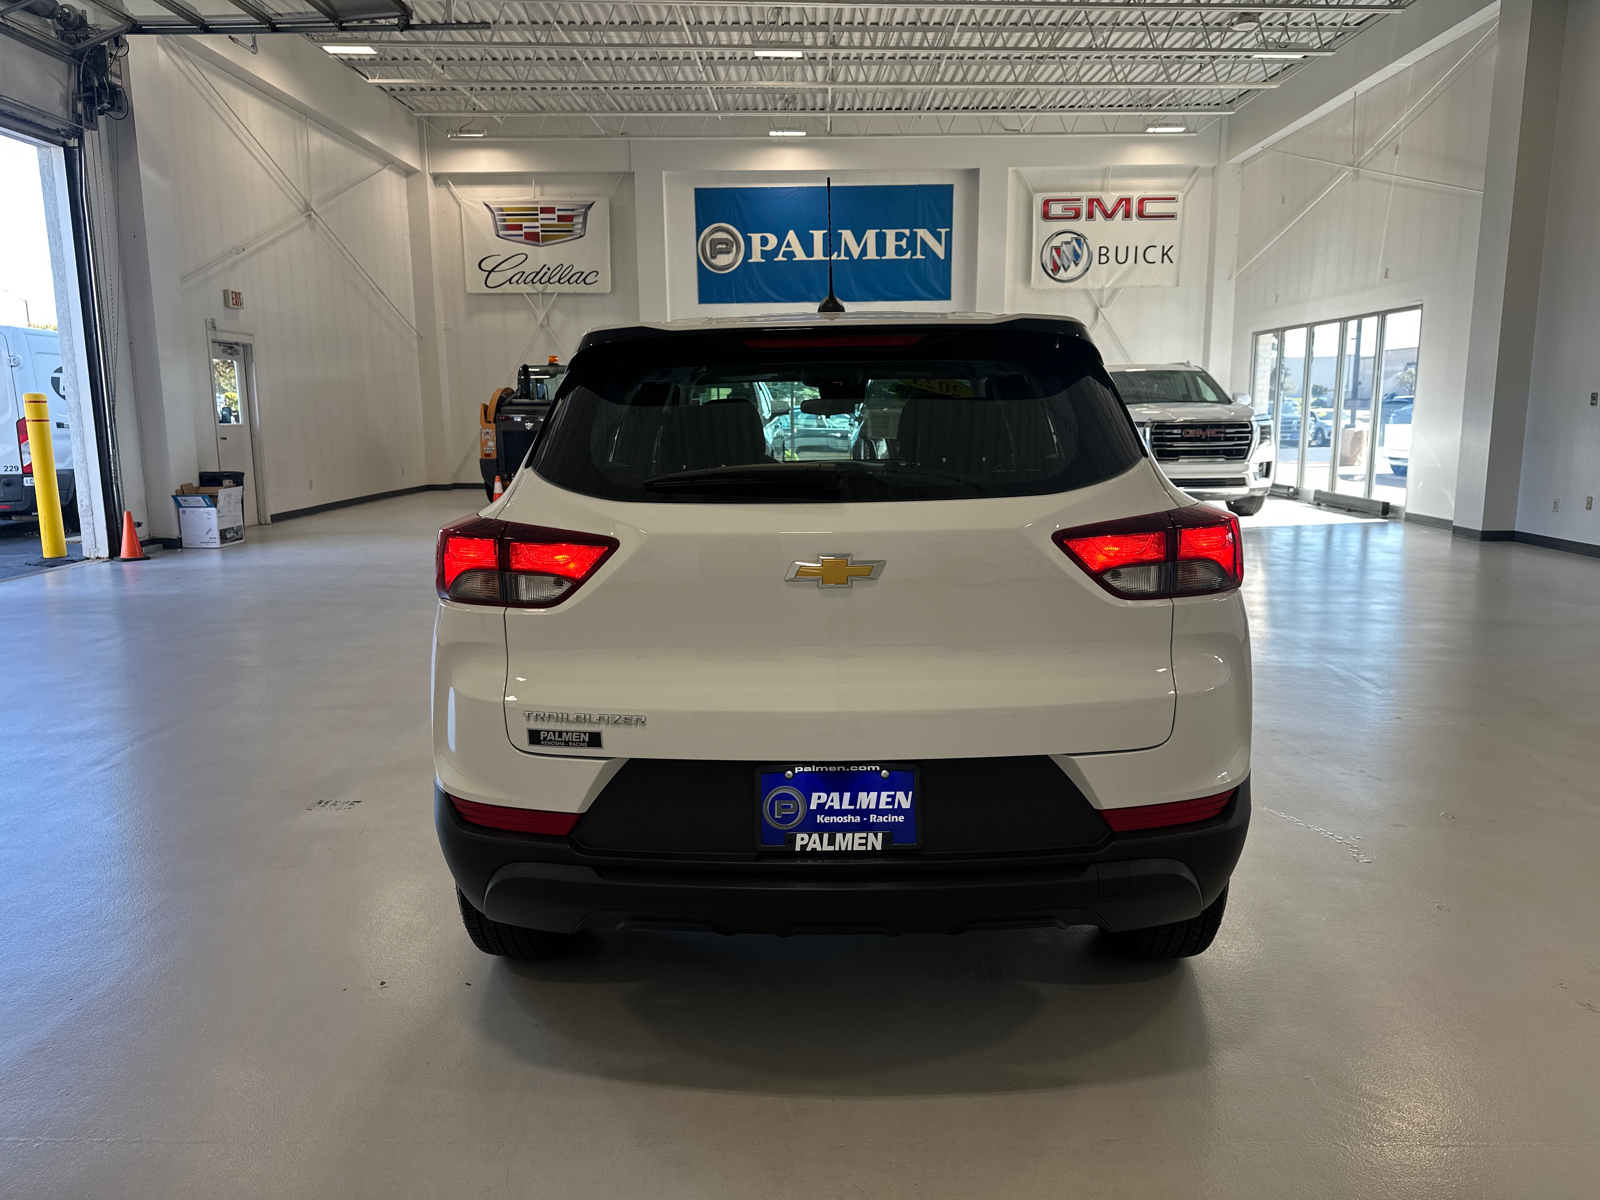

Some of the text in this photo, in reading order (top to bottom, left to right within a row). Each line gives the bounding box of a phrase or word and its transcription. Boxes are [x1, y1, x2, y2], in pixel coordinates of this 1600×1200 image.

[1041, 195, 1179, 222] GMC
[747, 228, 950, 263] PALMEN
[1098, 245, 1175, 265] BUICK
[477, 252, 599, 289] Cadillac
[1182, 428, 1226, 438] GMC
[523, 711, 647, 727] TRAILBLAZER
[540, 731, 589, 742] PALMEN
[794, 765, 880, 773] palmen.com
[809, 791, 913, 810] PALMEN
[816, 814, 861, 823] Kenosha
[869, 814, 905, 823] Racine
[795, 833, 883, 851] PALMEN
